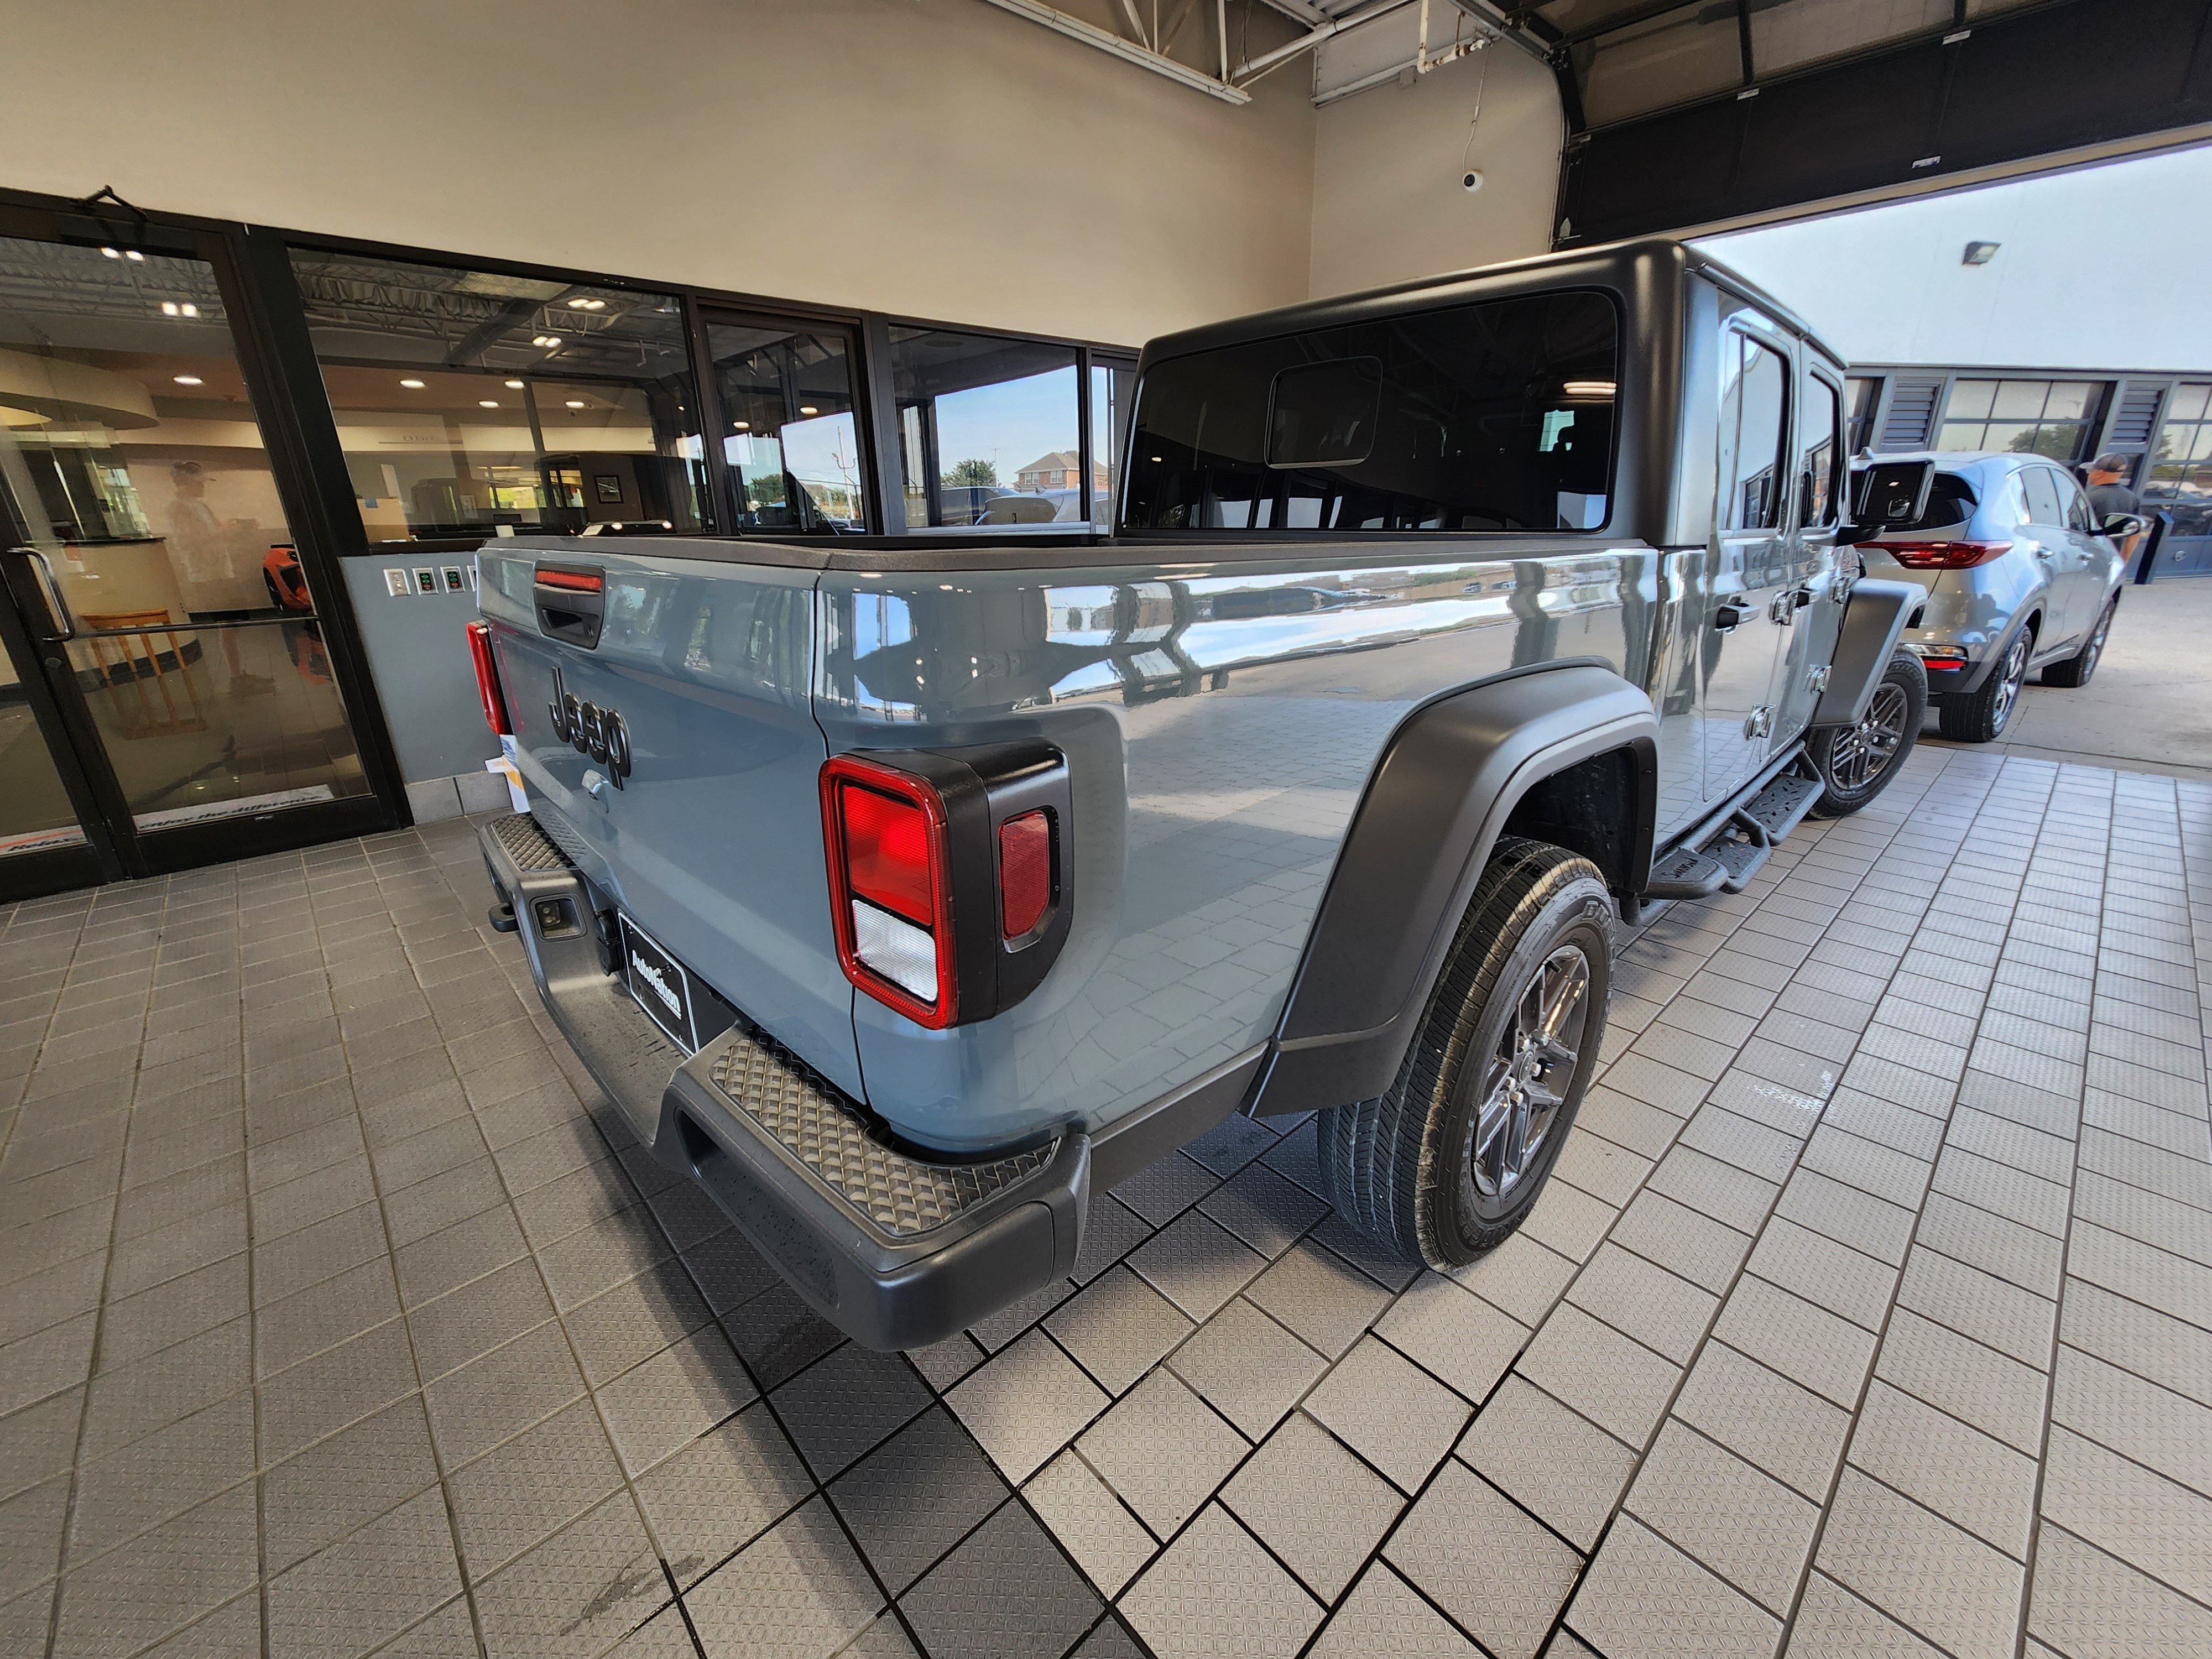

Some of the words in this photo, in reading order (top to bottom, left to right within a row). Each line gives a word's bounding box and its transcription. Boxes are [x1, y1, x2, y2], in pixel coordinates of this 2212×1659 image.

[549, 666, 632, 791] Jeep
[197, 811, 228, 820] the
[632, 949, 681, 1013] AutoNation
